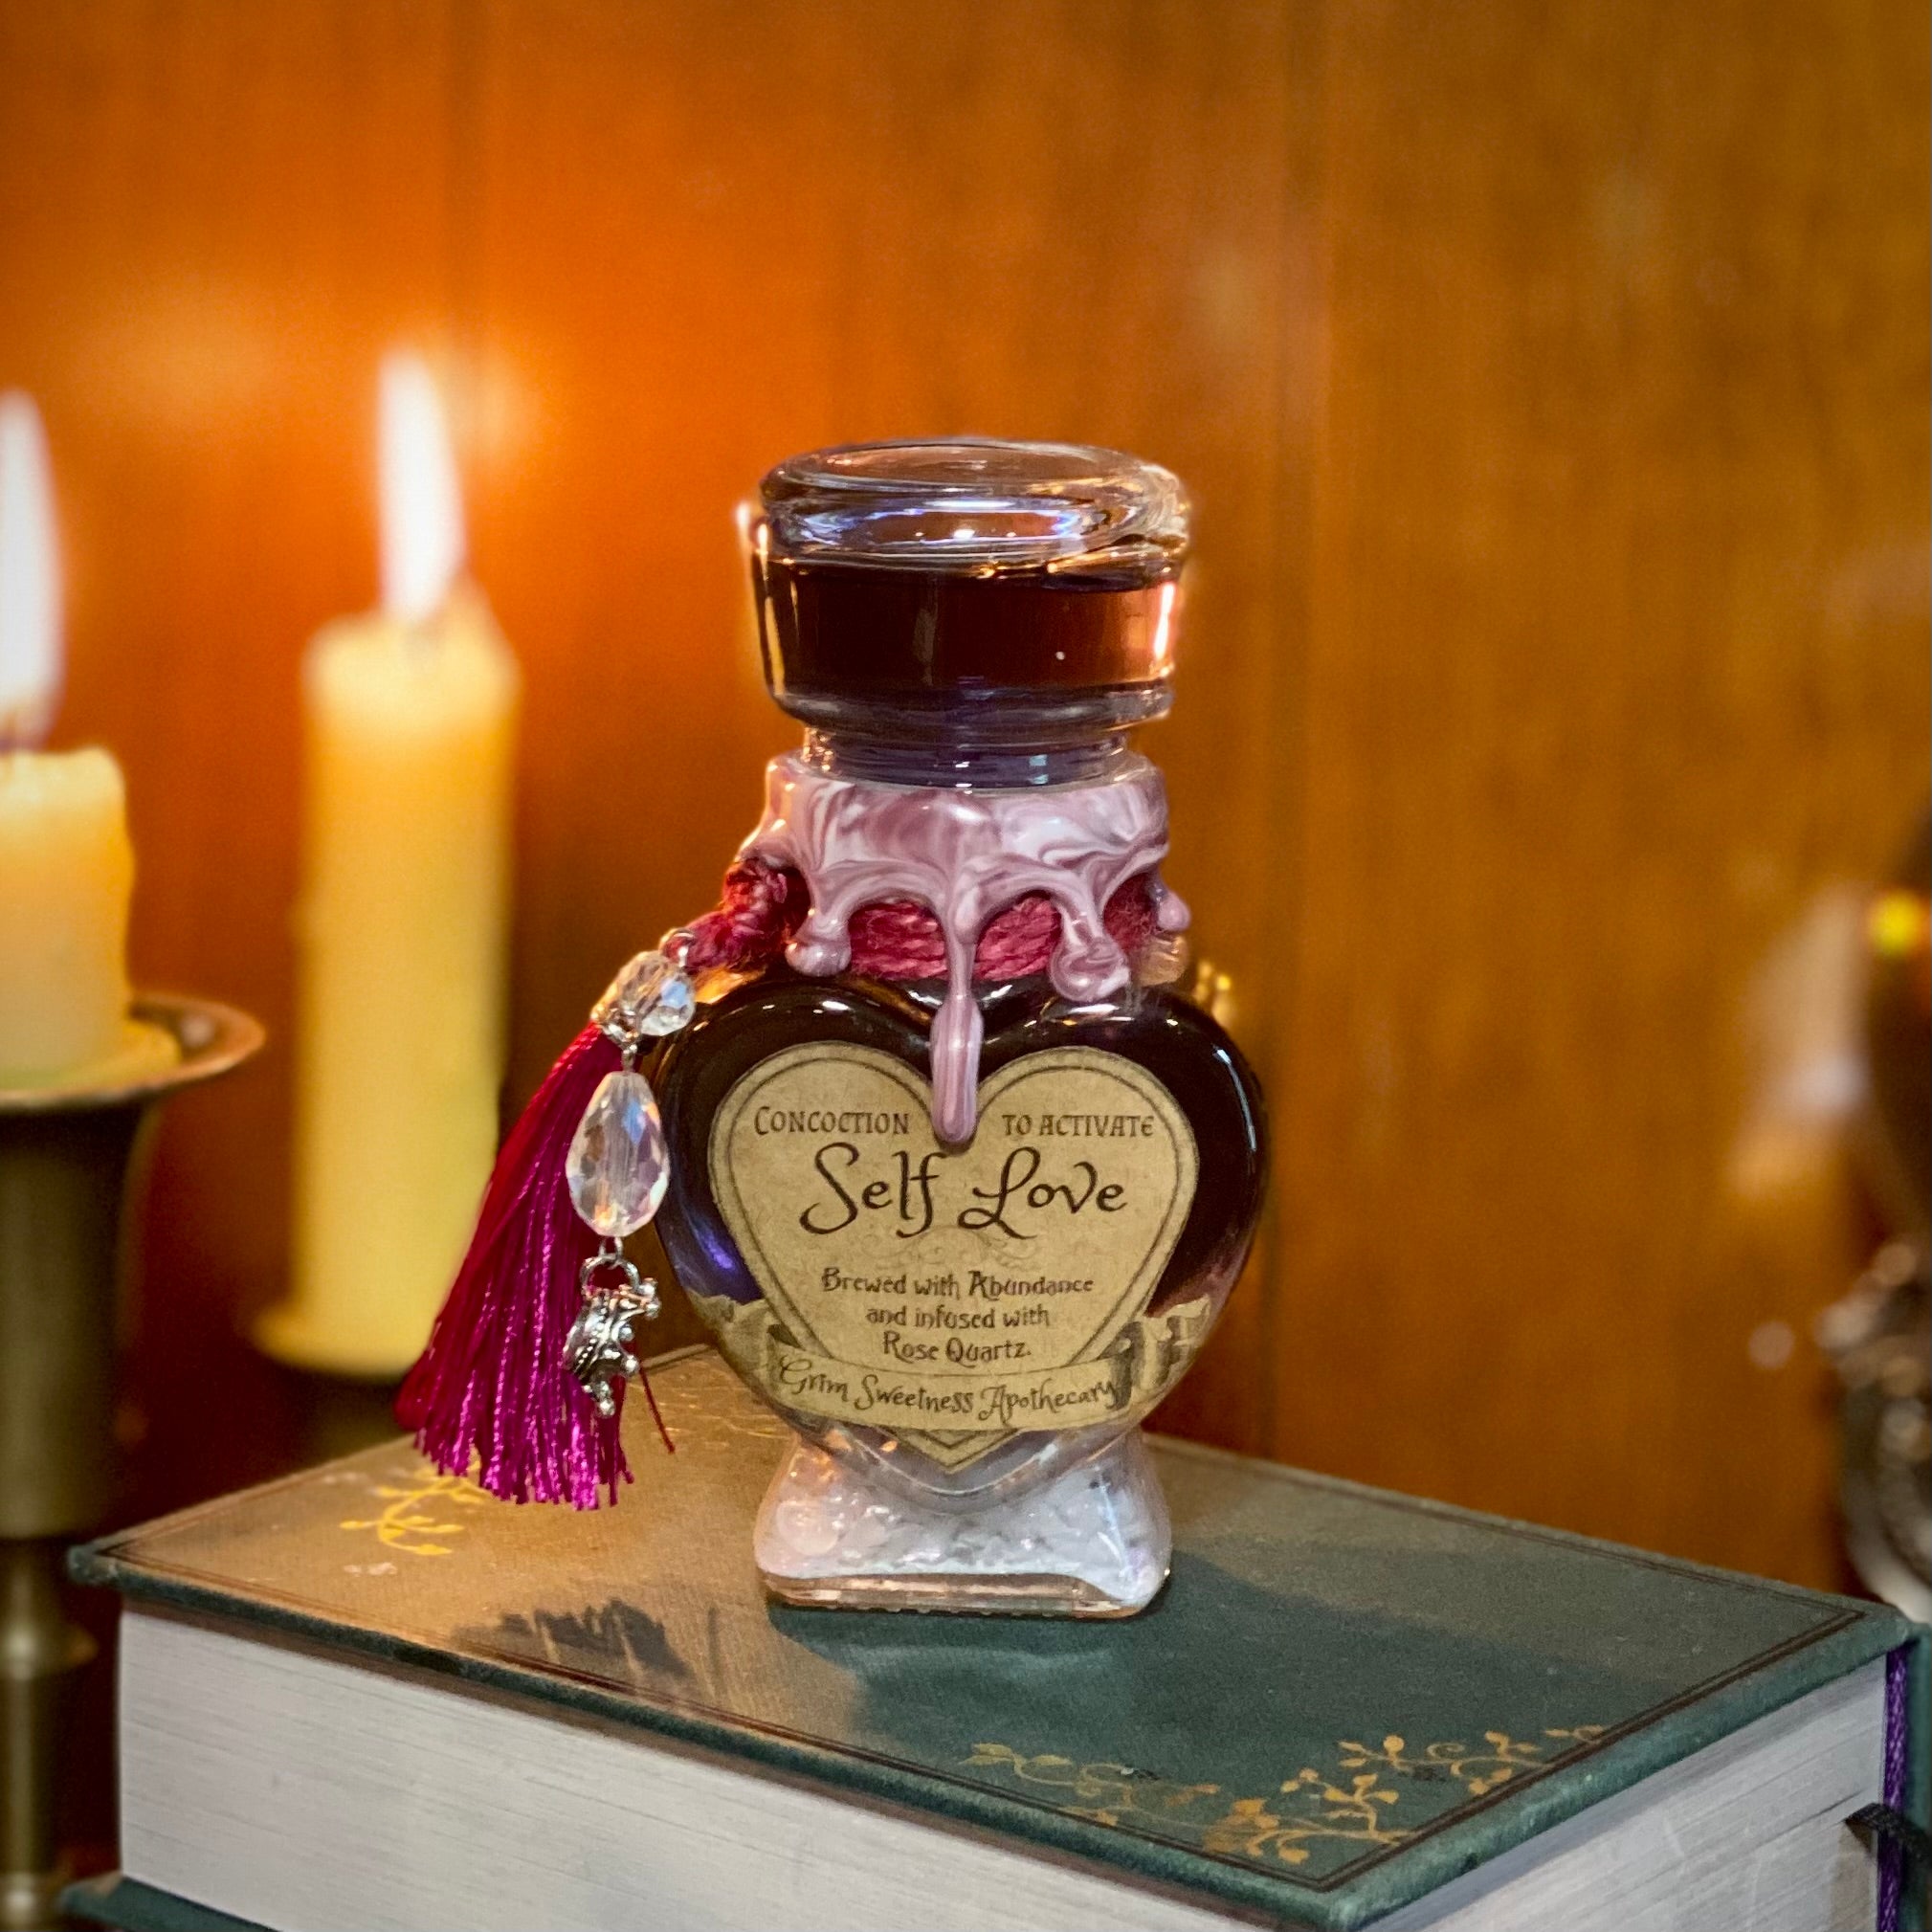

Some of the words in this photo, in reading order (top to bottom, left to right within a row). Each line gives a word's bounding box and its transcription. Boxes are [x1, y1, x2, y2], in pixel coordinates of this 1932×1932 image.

[754, 1106, 910, 1136] CONCOCTION
[1002, 1113, 1033, 1137] TO
[1038, 1114, 1155, 1138] ACTIVATE
[799, 1142, 952, 1239] Self
[957, 1146, 1128, 1240] Love
[821, 1267, 907, 1295] Brewed
[914, 1269, 959, 1299] with
[967, 1269, 1095, 1300] Abundance
[866, 1305, 908, 1327] and
[914, 1304, 995, 1330] infused
[1002, 1305, 1051, 1329] with
[882, 1330, 939, 1364] Rose
[944, 1337, 1032, 1368] Quartz.
[778, 1355, 849, 1404] Grim
[854, 1373, 974, 1414] Sweetness
[978, 1376, 1121, 1430] Apothecary
